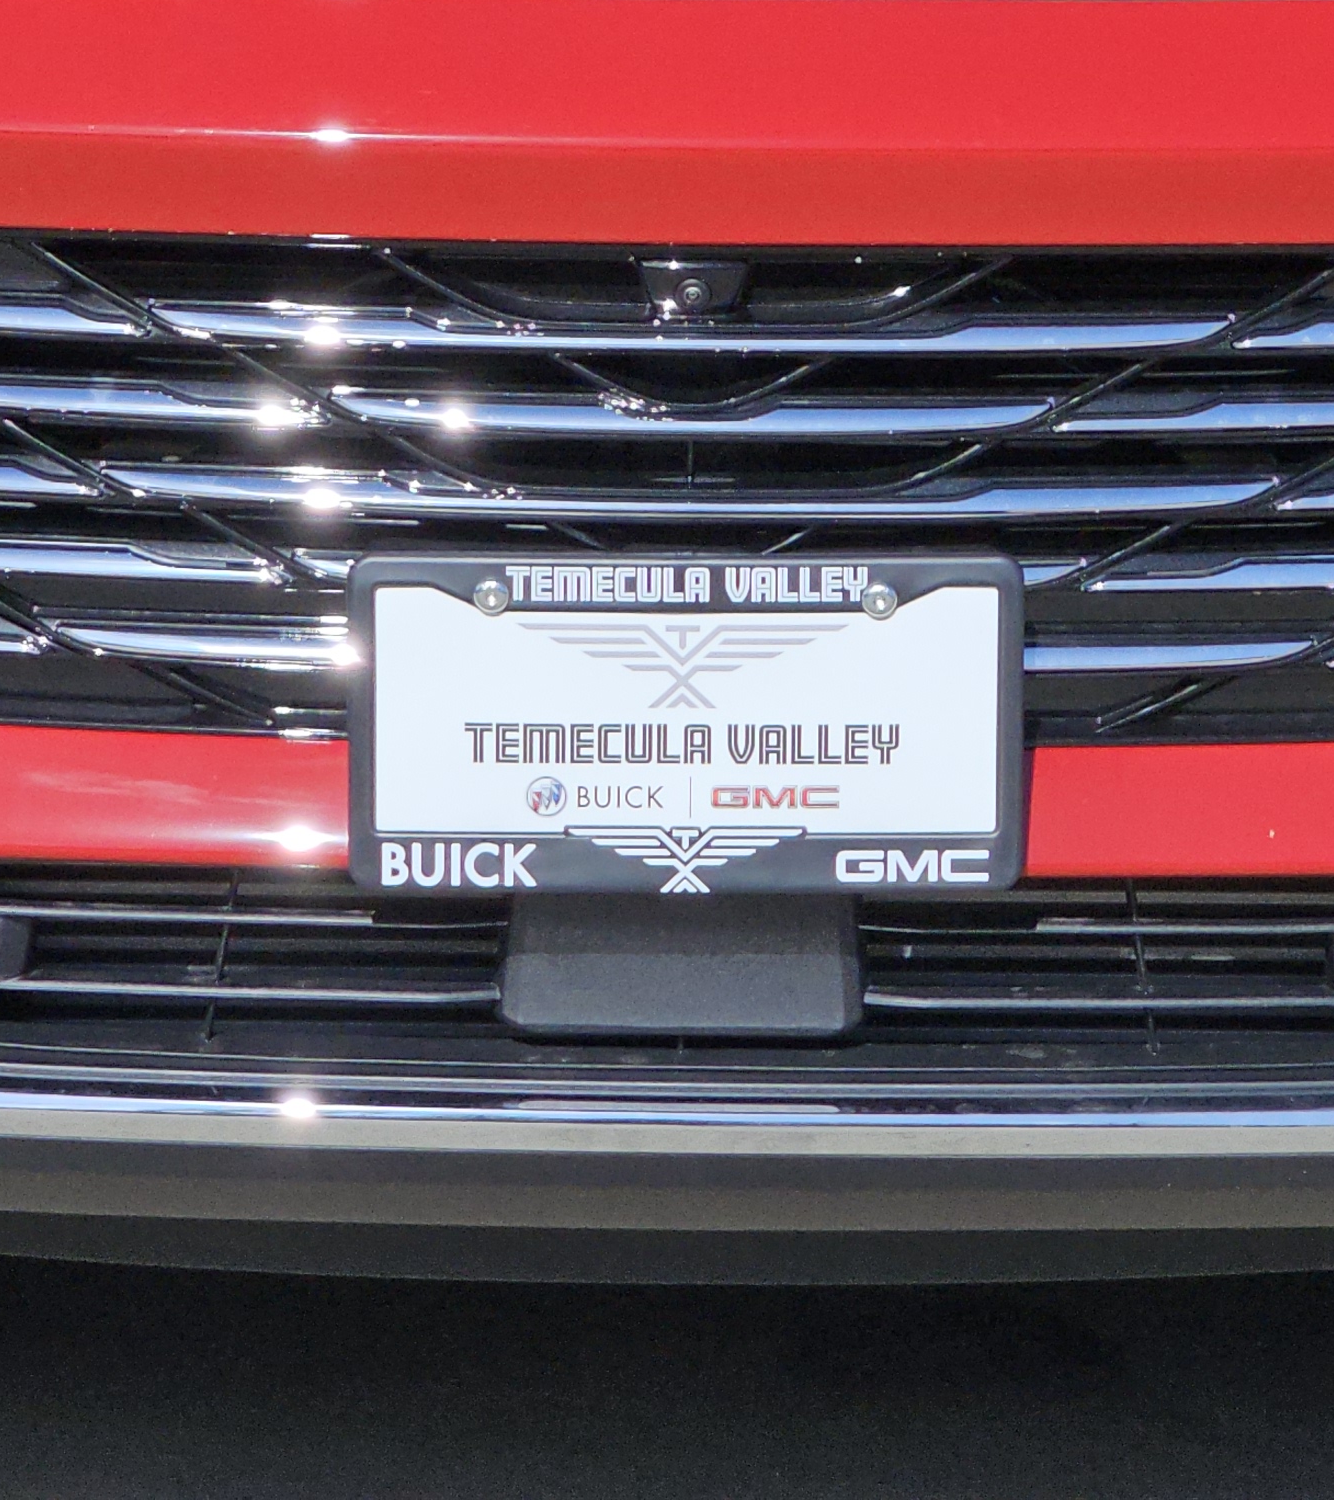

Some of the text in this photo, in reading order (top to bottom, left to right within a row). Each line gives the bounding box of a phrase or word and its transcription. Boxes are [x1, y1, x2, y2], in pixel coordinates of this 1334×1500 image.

[506, 566, 868, 603] TEMECULA VALLEY
[465, 723, 900, 765] TEMECULA VALLEY
[576, 784, 841, 810] BUICK GMC
[381, 843, 537, 888] BUICK
[835, 850, 990, 884] GMC
